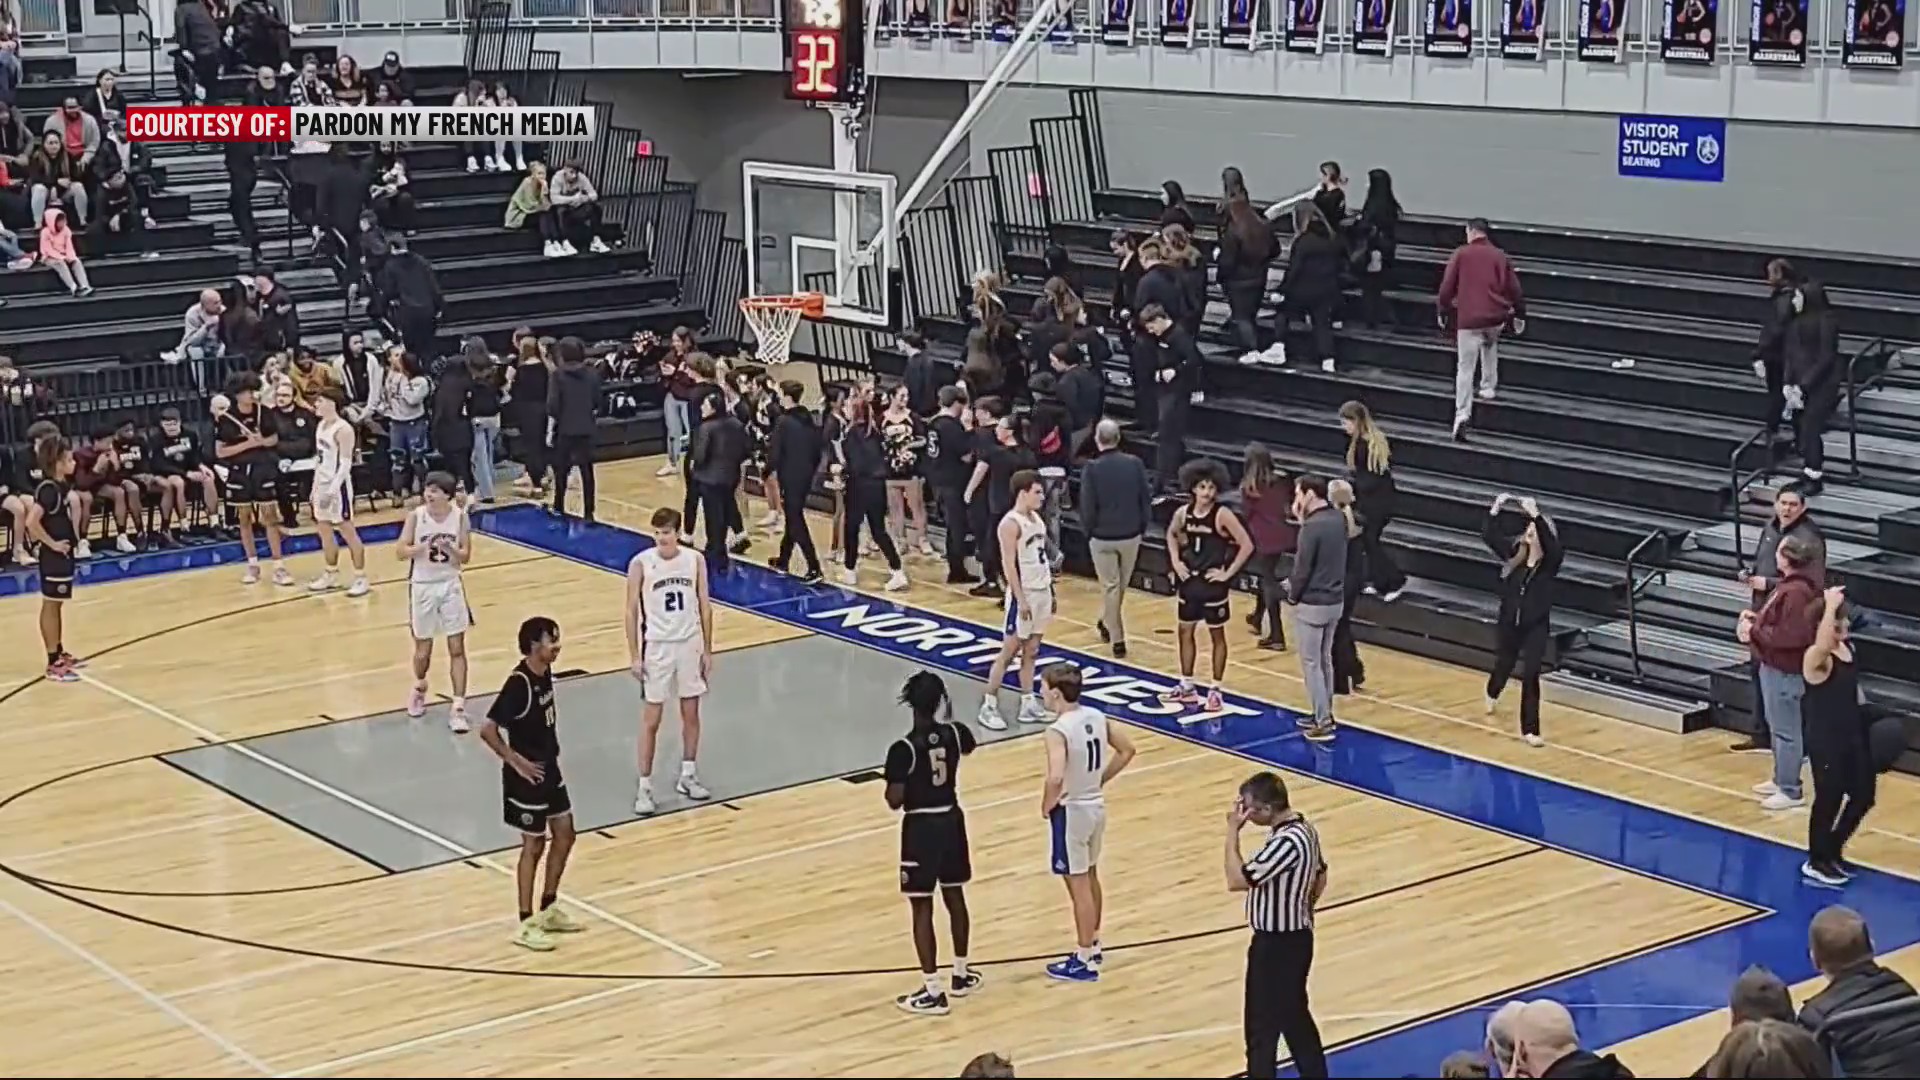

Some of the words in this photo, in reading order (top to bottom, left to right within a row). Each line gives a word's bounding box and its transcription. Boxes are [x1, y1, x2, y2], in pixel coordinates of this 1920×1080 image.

[797, 35, 837, 93] 32
[1623, 122, 1679, 139] VISITOR
[1622, 139, 1690, 157] STUDENT
[1622, 156, 1661, 168] SEATING
[665, 590, 684, 611] 21
[1086, 738, 1101, 772] 11
[929, 747, 947, 786] 5
